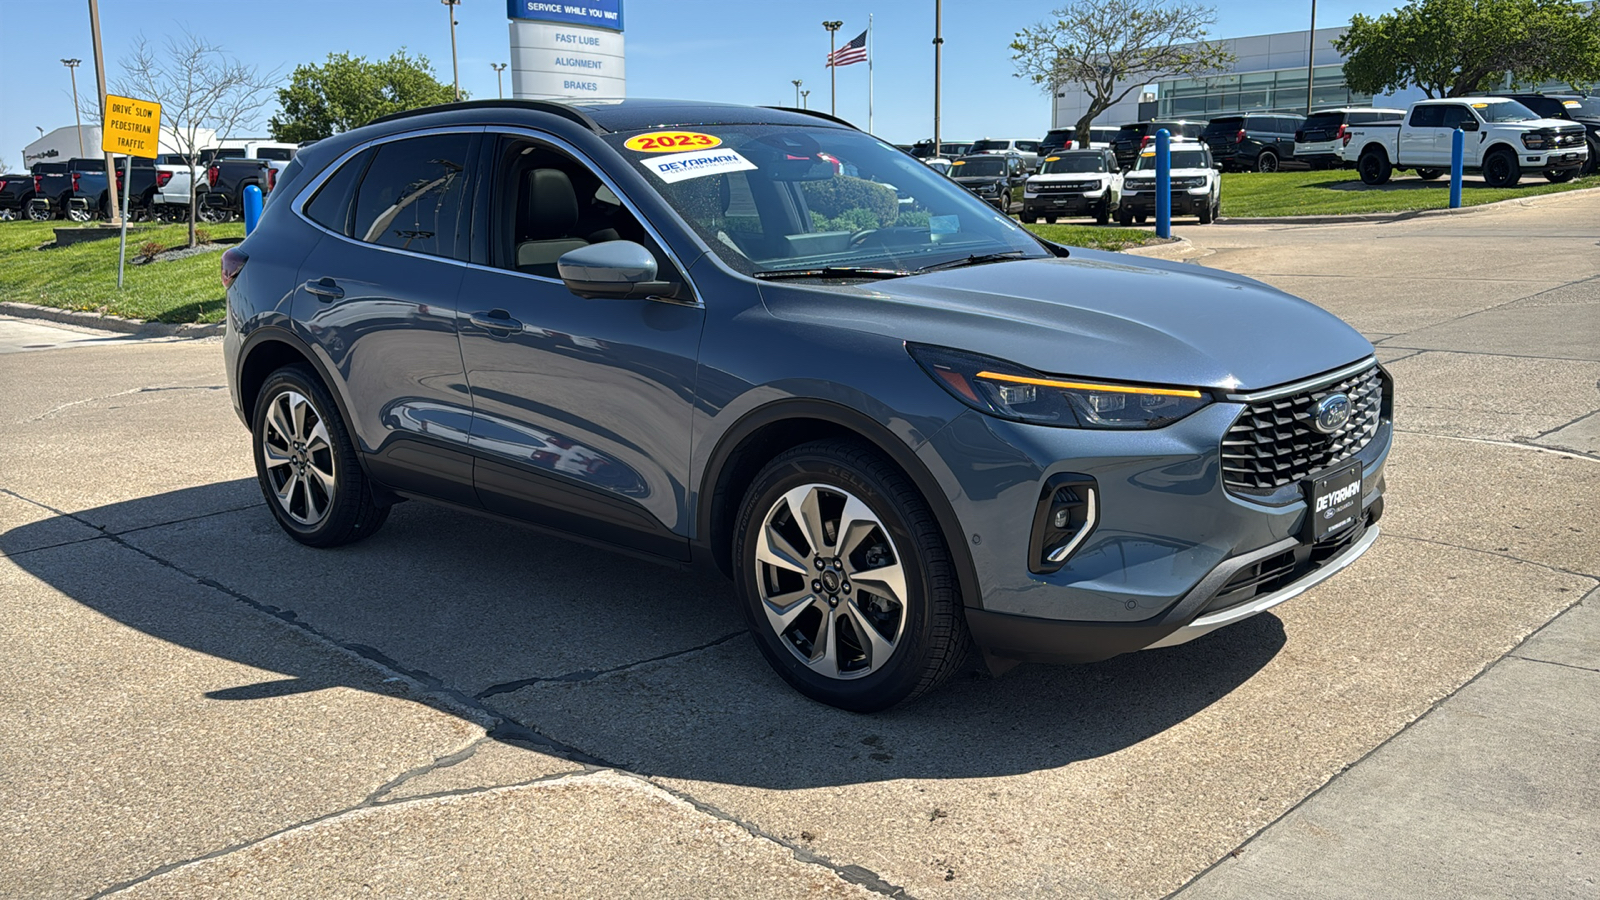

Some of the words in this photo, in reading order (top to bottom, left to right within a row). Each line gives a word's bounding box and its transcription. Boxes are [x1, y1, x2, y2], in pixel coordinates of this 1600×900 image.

[527, 2, 562, 13] SERVICE
[564, 5, 587, 16] WHILE
[588, 8, 603, 18] YOU
[603, 10, 618, 20] WAIT
[555, 33, 577, 43] FAST
[578, 35, 600, 46] LUBE
[555, 57, 602, 69] ALIGNMENT
[563, 80, 597, 92] BRAKES
[112, 103, 132, 115] DRIVE
[135, 107, 153, 118] SLOW
[110, 119, 152, 134] PEDESTRIAN
[117, 136, 145, 150] TRAFFIC
[638, 135, 713, 149] 2023
[658, 155, 739, 172] DEYARMAN
[827, 466, 878, 498] KELLY
[1315, 479, 1361, 513] DEYARMAN
